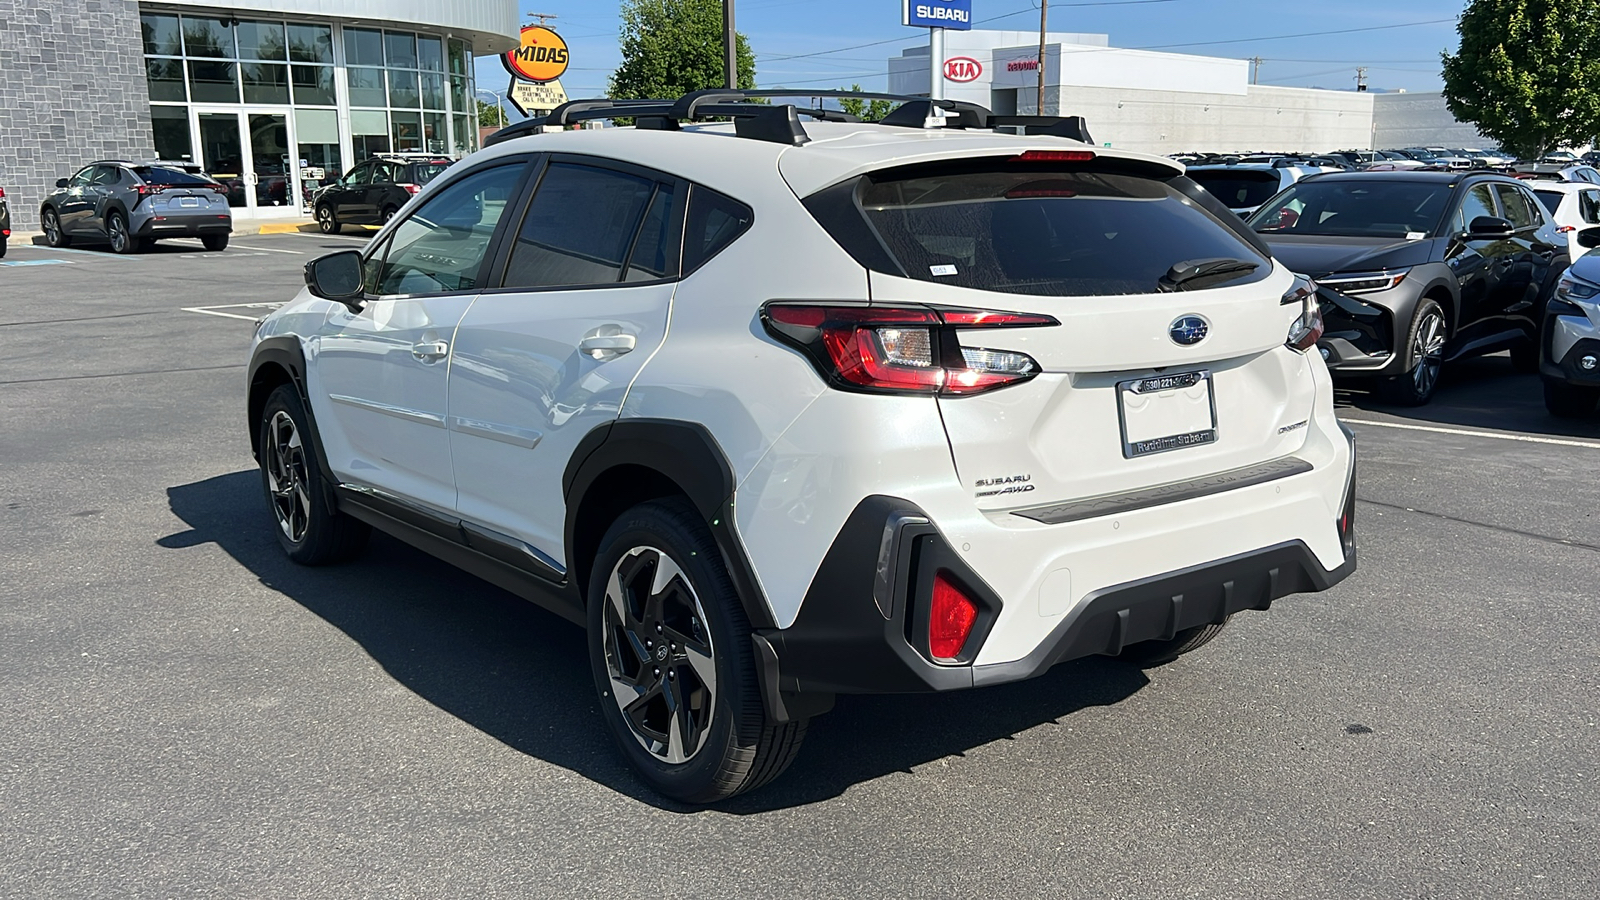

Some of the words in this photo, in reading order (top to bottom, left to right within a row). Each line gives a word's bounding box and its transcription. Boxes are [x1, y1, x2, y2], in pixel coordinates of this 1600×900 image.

[916, 5, 969, 22] SUBARU
[514, 45, 568, 64] MIDAS
[948, 62, 976, 77] KIA
[1007, 61, 1039, 71] REDDIN
[975, 474, 1031, 487] SUBARU
[998, 484, 1035, 495] AWD
